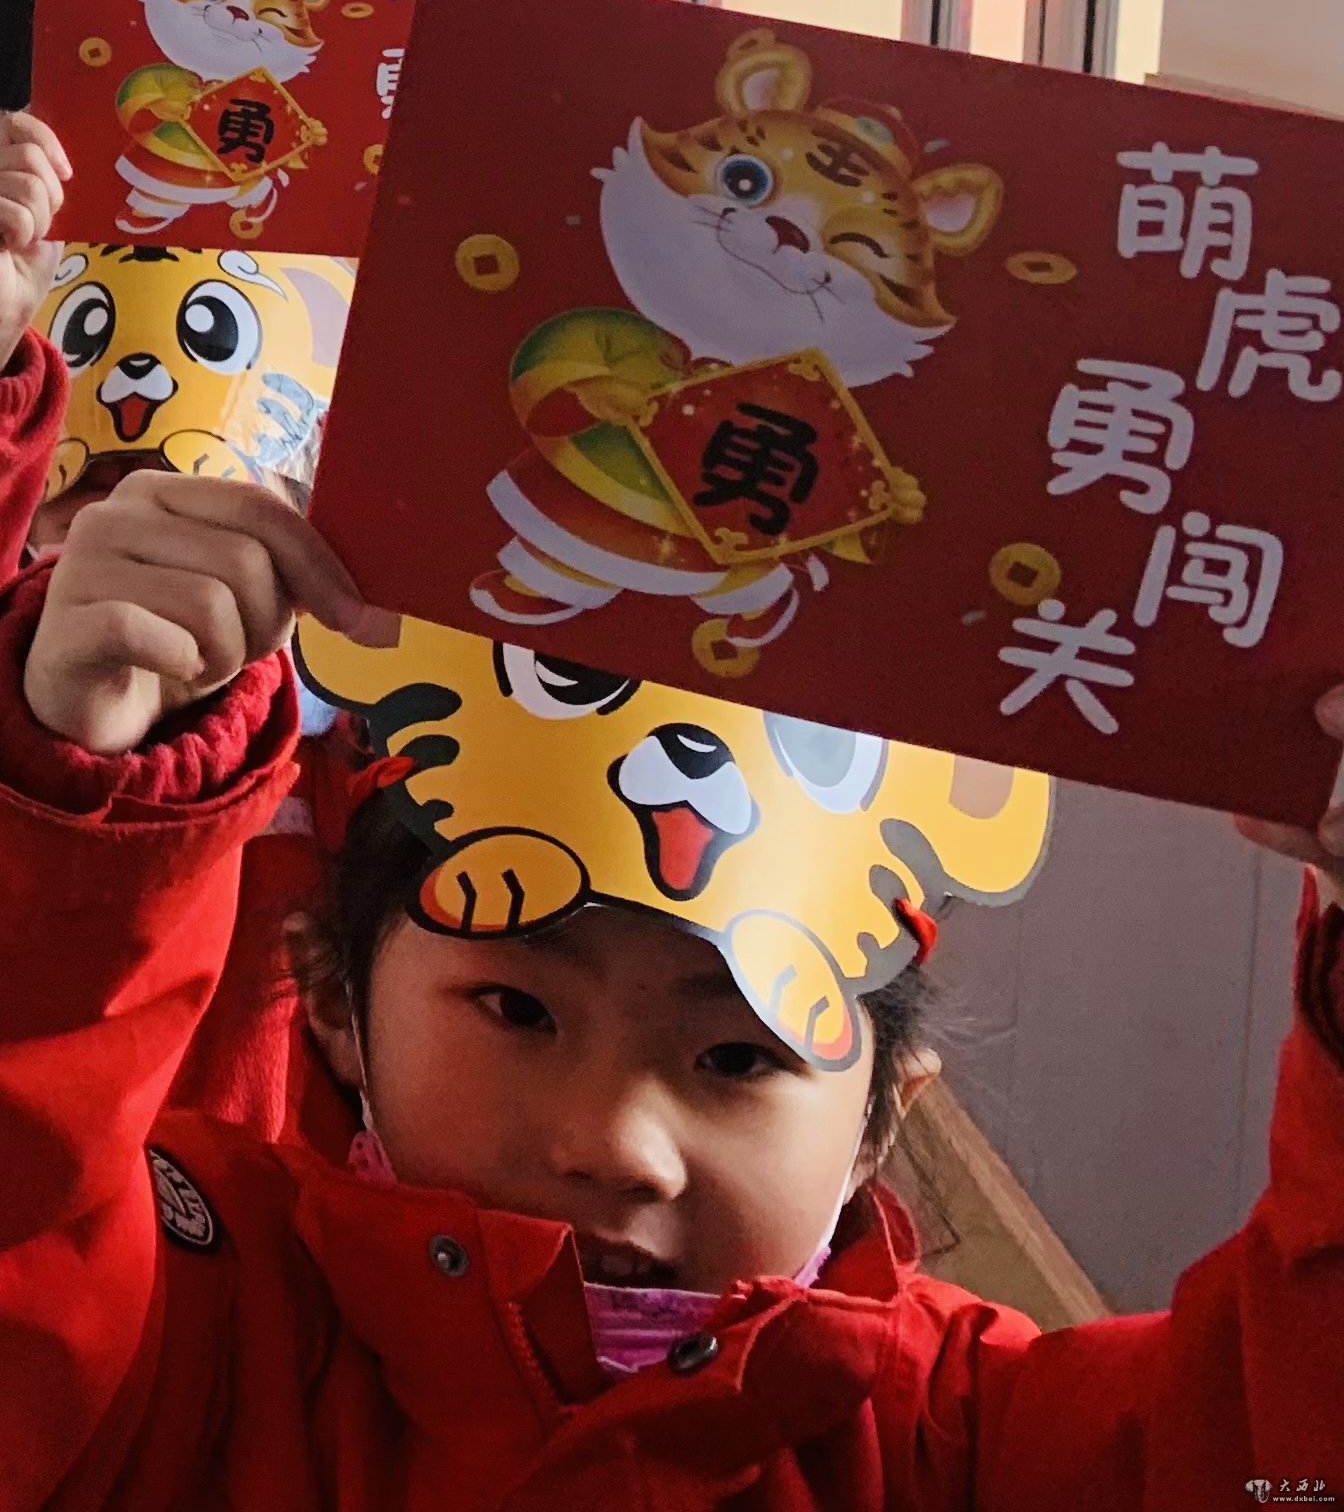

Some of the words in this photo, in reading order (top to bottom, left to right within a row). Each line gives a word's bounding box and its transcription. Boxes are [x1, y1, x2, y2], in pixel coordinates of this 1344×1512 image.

[216, 98, 275, 164] 勇
[694, 402, 819, 536] 勇
[998, 141, 1343, 735] 萌虎勇闯关
